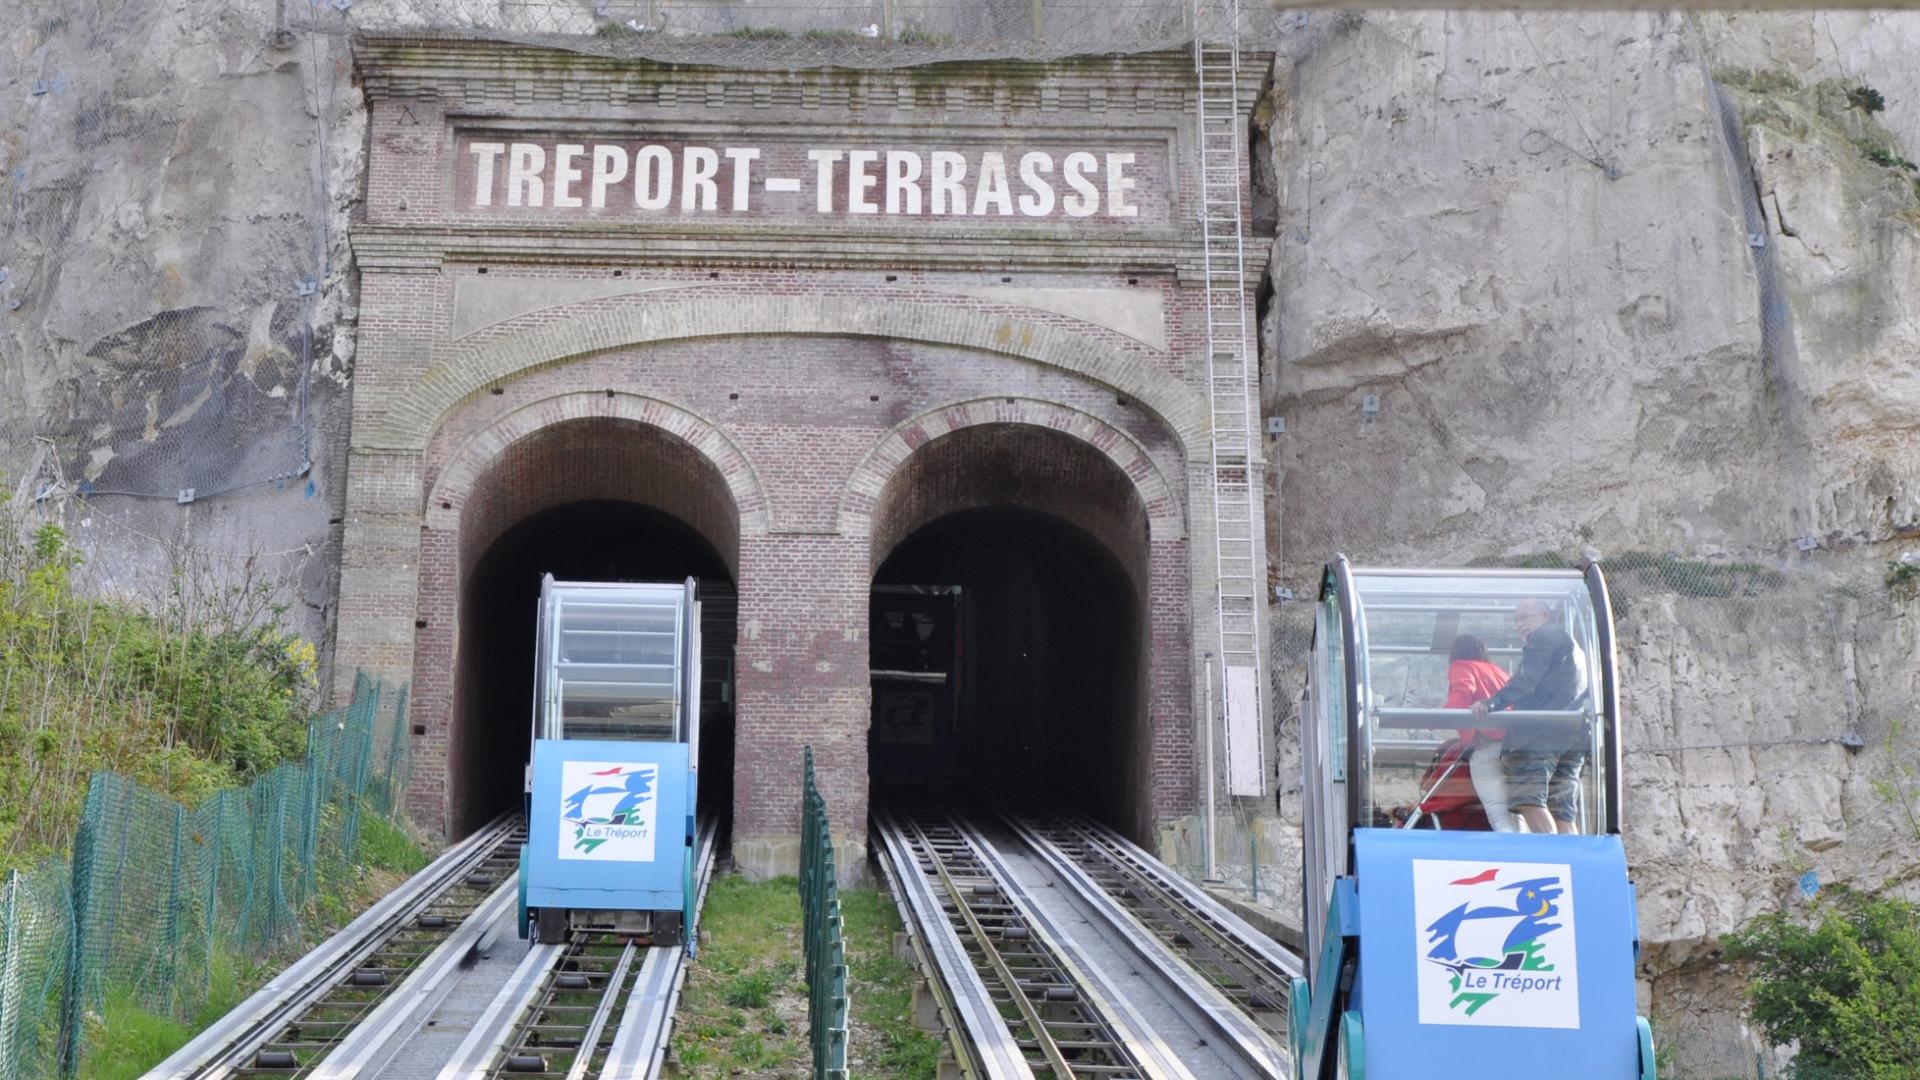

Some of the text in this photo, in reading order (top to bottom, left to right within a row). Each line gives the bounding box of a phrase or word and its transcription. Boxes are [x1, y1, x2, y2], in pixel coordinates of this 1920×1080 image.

[586, 827, 647, 839] Le Tréport
[1465, 972, 1562, 993] Le Tréport
